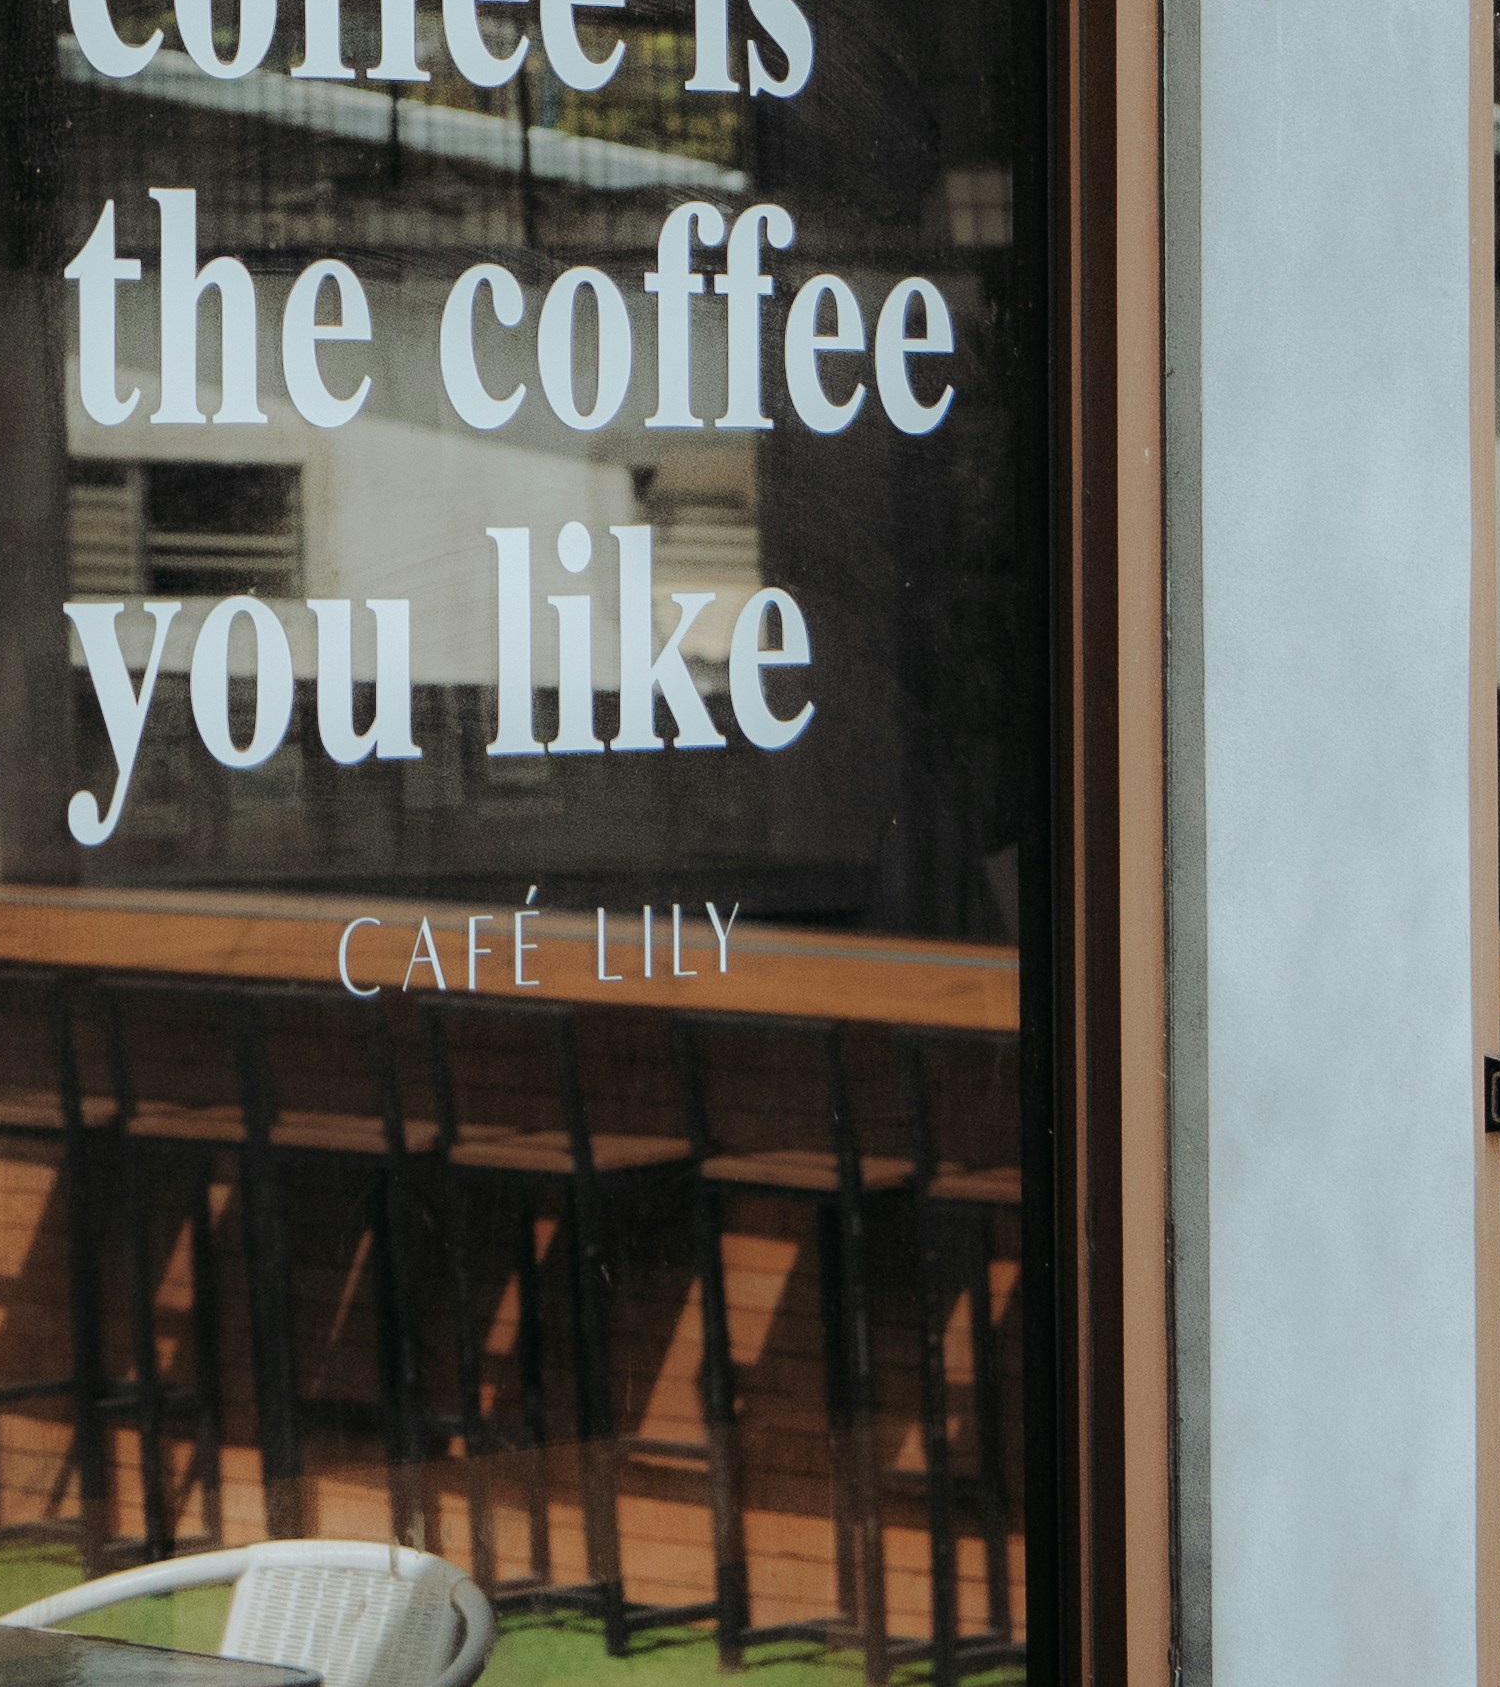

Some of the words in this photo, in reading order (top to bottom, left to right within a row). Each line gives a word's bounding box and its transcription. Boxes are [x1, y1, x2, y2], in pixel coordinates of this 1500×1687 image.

[63, 187, 373, 429] the
[438, 200, 955, 435] coffee
[62, 594, 423, 845] you
[484, 520, 815, 755] like
[338, 885, 541, 996] CAFÉ
[597, 902, 740, 981] LILY
